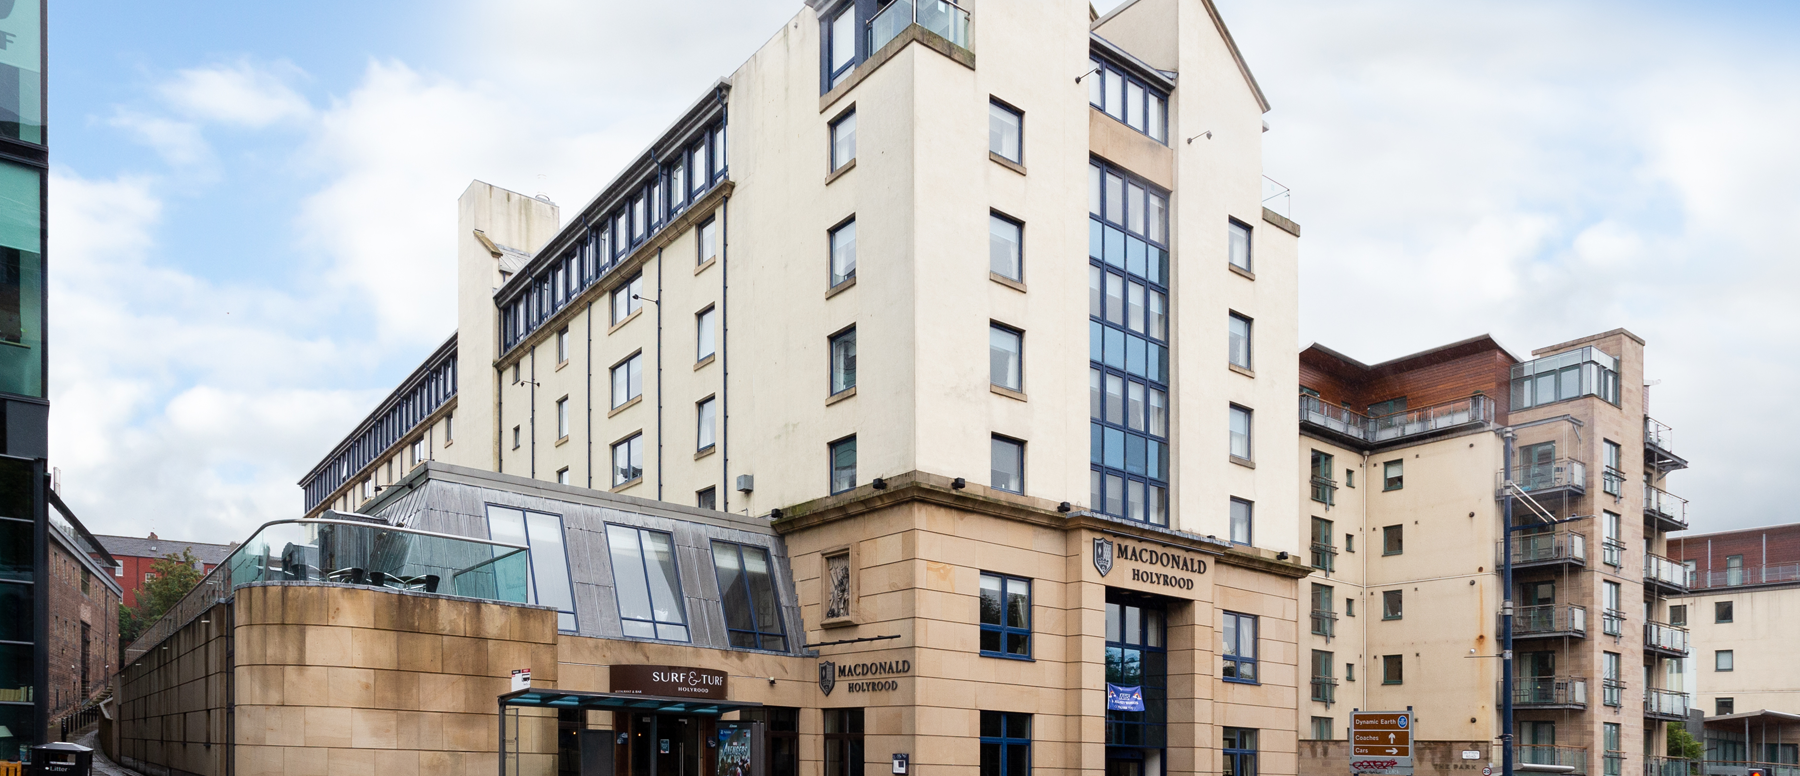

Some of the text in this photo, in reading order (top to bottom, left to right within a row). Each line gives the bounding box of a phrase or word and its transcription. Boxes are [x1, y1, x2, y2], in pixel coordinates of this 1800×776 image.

[1117, 543, 1207, 575] MACDONALD
[1132, 568, 1194, 590] HOLYROOD
[838, 660, 911, 678] MACDONALD
[652, 670, 724, 686] SURF & TURF
[678, 686, 709, 694] HOLYROOD
[848, 680, 898, 693] HOLYROOD
[1355, 718, 1379, 726] Dynamic
